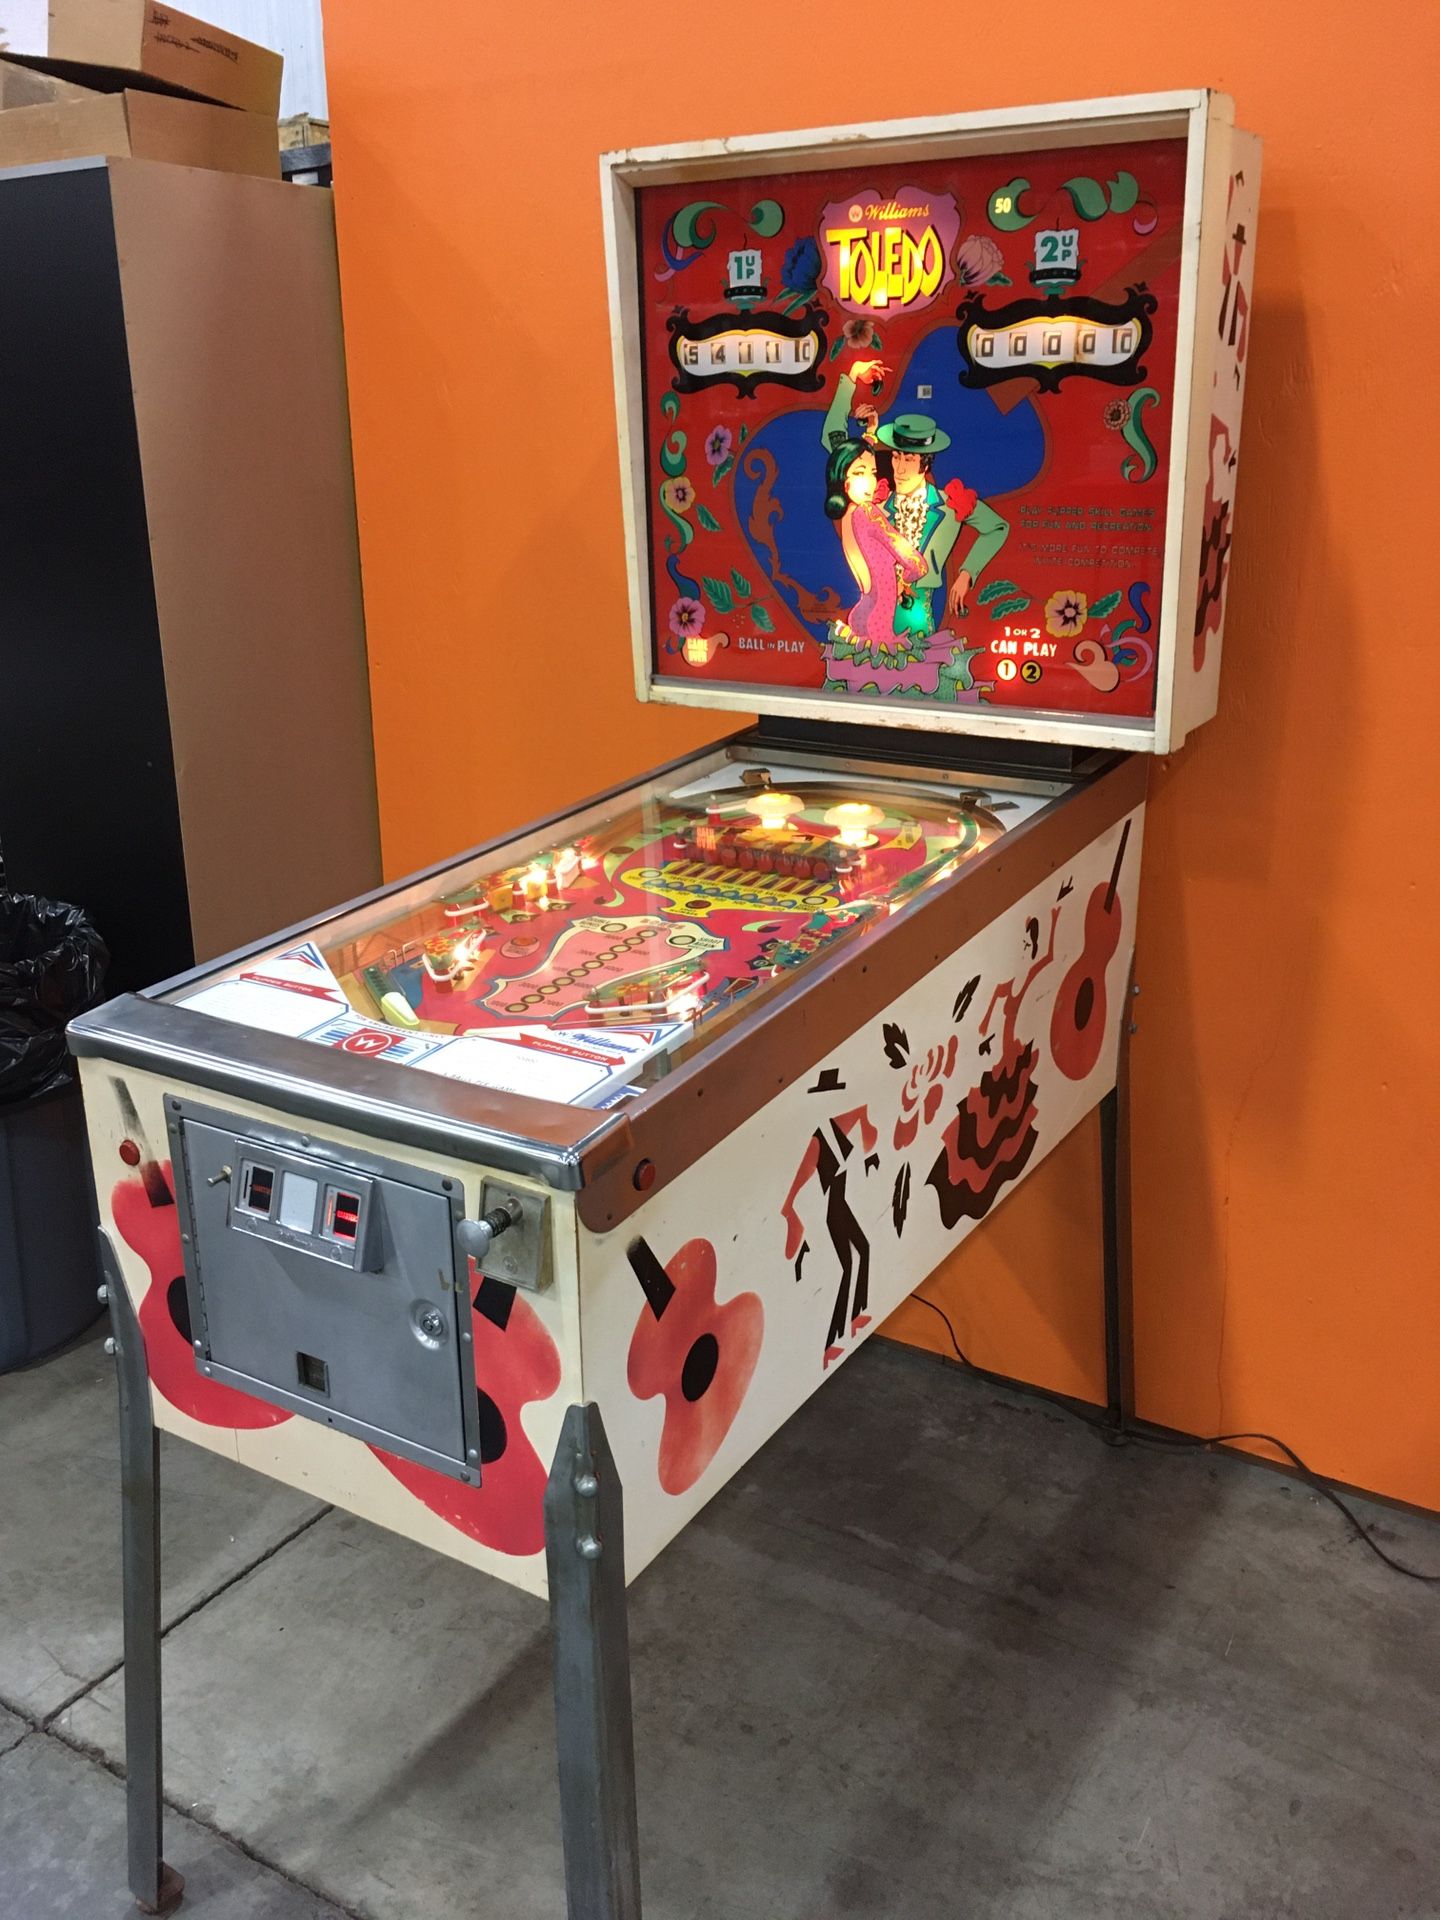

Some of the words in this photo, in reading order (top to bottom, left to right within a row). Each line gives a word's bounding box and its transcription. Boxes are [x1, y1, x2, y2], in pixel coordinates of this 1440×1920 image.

[864, 201, 930, 221] Williams
[994, 198, 1012, 214] 50
[825, 224, 944, 307] TOLEDO
[1029, 627, 1041, 639] 2
[738, 636, 765, 651] BALL
[777, 639, 805, 654] PLAY
[990, 640, 1018, 655] CAN
[1023, 641, 1058, 657] PLAY
[531, 1039, 570, 1053] FLIPPER
[571, 1049, 609, 1063] BUTTON
[571, 1031, 638, 1054] Williams
